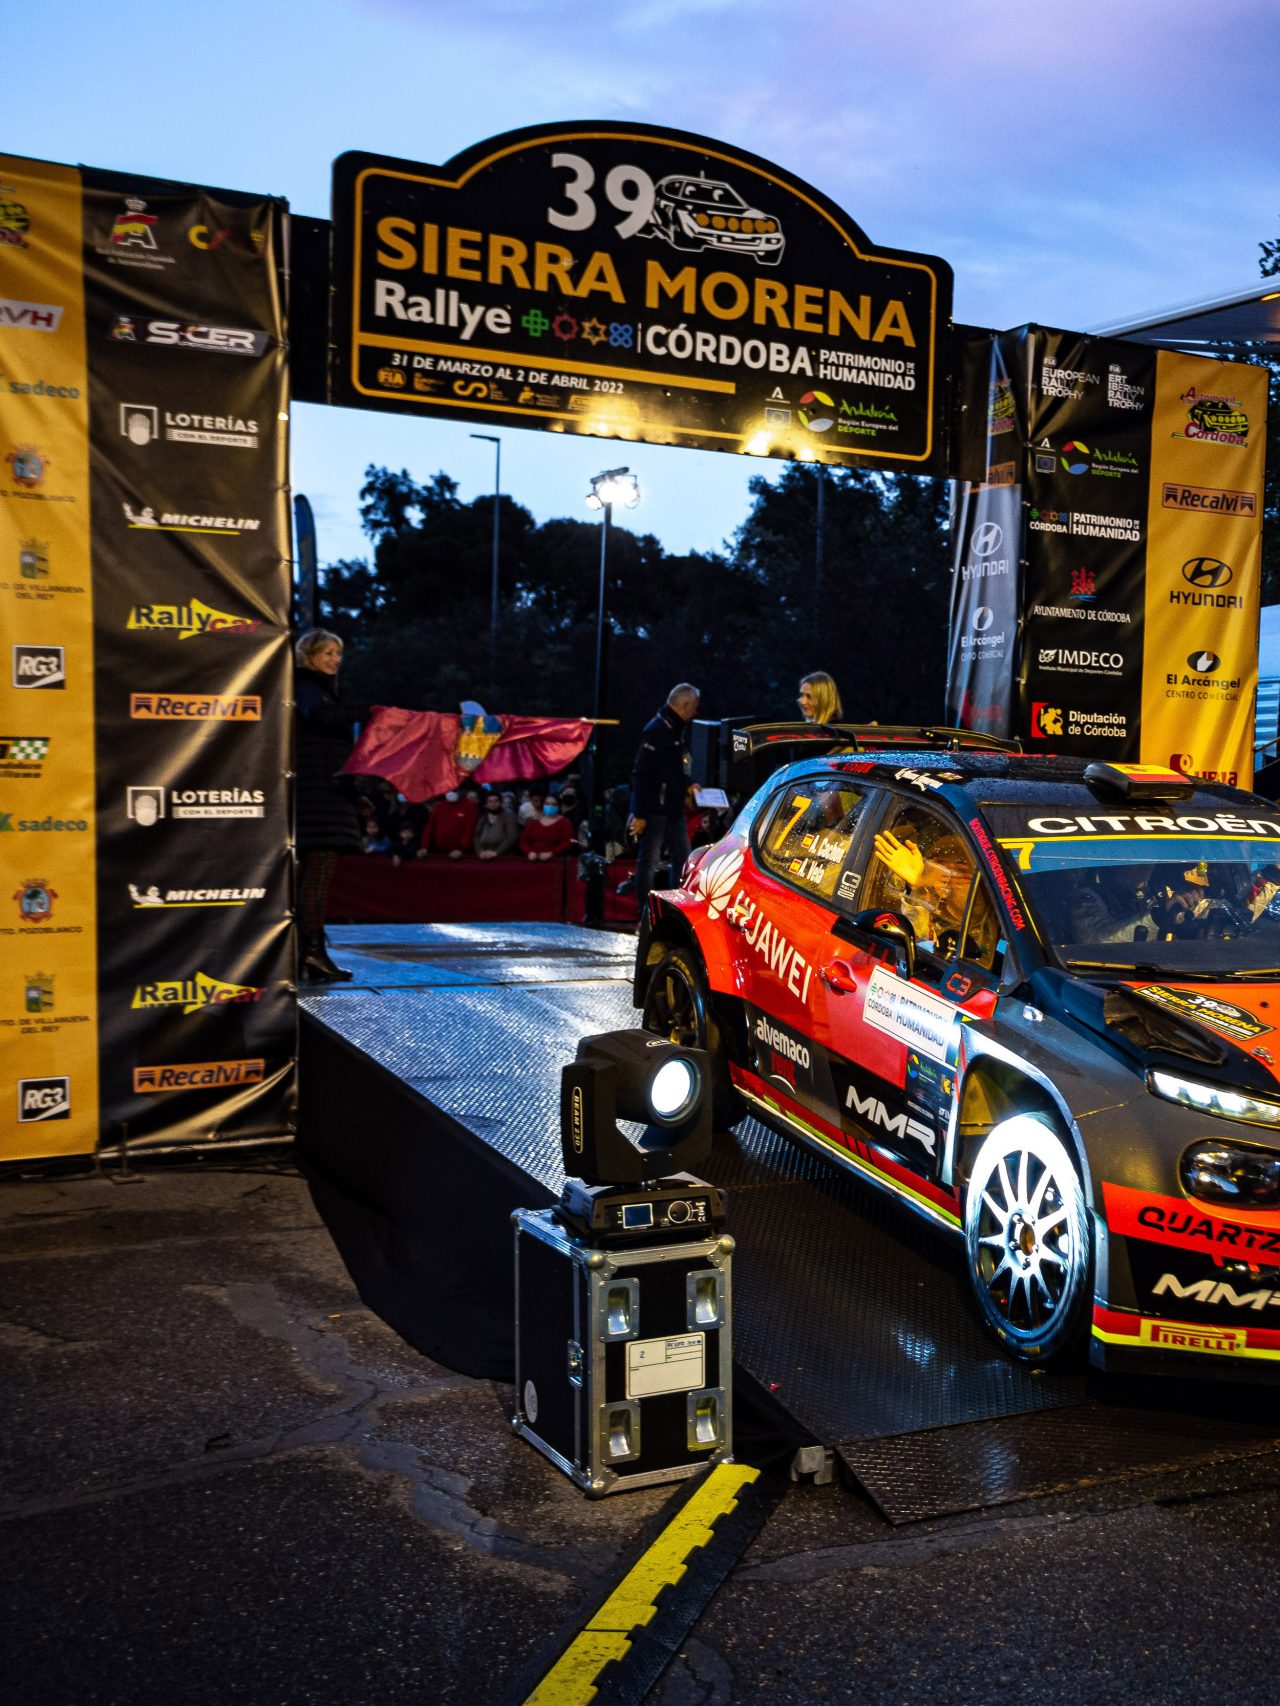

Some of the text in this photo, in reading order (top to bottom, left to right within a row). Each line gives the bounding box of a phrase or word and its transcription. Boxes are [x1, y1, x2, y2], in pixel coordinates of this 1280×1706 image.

[547, 152, 655, 240] 39
[375, 216, 918, 348] SIERRA MORENA
[374, 279, 512, 341] Rallye
[645, 322, 814, 377] CÓRDOBA
[819, 349, 905, 374] PATRIMONIO
[391, 353, 408, 367] 31
[412, 355, 433, 371] DE
[437, 359, 493, 378] MARZO
[516, 369, 525, 382] 2
[528, 371, 548, 385] DE
[551, 374, 590, 390] ABRIL
[593, 379, 625, 394] 2022
[818, 364, 916, 391] HUMANIDAD
[1041, 377, 1075, 389] RALLY
[1042, 367, 1100, 384] EUROPEAN
[1107, 374, 1127, 384] ERT
[1041, 386, 1084, 400] TROPHY
[1107, 382, 1144, 395] IBERIAN
[1107, 390, 1137, 401] RALLY
[1107, 398, 1144, 411] TROPHY
[165, 412, 259, 433] LOTERÍAS
[1180, 489, 1240, 512] Recalvi
[161, 513, 260, 530] MICHELIN
[1029, 520, 1068, 534] CÓRDOBA
[1073, 512, 1132, 529] PATRIMONIO
[1072, 524, 1140, 541] HUMANIDAD
[1169, 591, 1243, 609] HYUNDAI
[1034, 605, 1131, 623] AYUNTAMIENTO DE CÓRDOBA
[19, 655, 58, 677] RG3
[1058, 649, 1123, 668] IMDECO
[1166, 674, 1240, 690] El Arcángel
[1165, 690, 1195, 699] CENTRO
[155, 697, 239, 717] Recalvi
[1068, 710, 1126, 725] Diputación
[1068, 724, 1126, 737] de Córdoba
[172, 787, 264, 804] LOTERÍAS
[18, 816, 88, 831] sadeco
[773, 795, 812, 850] 7
[1001, 841, 1035, 870] 7
[166, 887, 267, 901] MICHELIN
[733, 888, 812, 1005] HUAWEI
[1149, 985, 1197, 1010] SIERRA
[1199, 1008, 1261, 1033] MORENA
[1187, 995, 1218, 1010] 39
[896, 1011, 945, 1047] HUMANIDAD
[756, 1016, 809, 1069] alvemaco
[158, 1062, 243, 1088] Recalvi
[23, 1087, 64, 1110] RG3
[845, 1085, 936, 1157] MMR
[1151, 1324, 1236, 1352] PIRELLI
